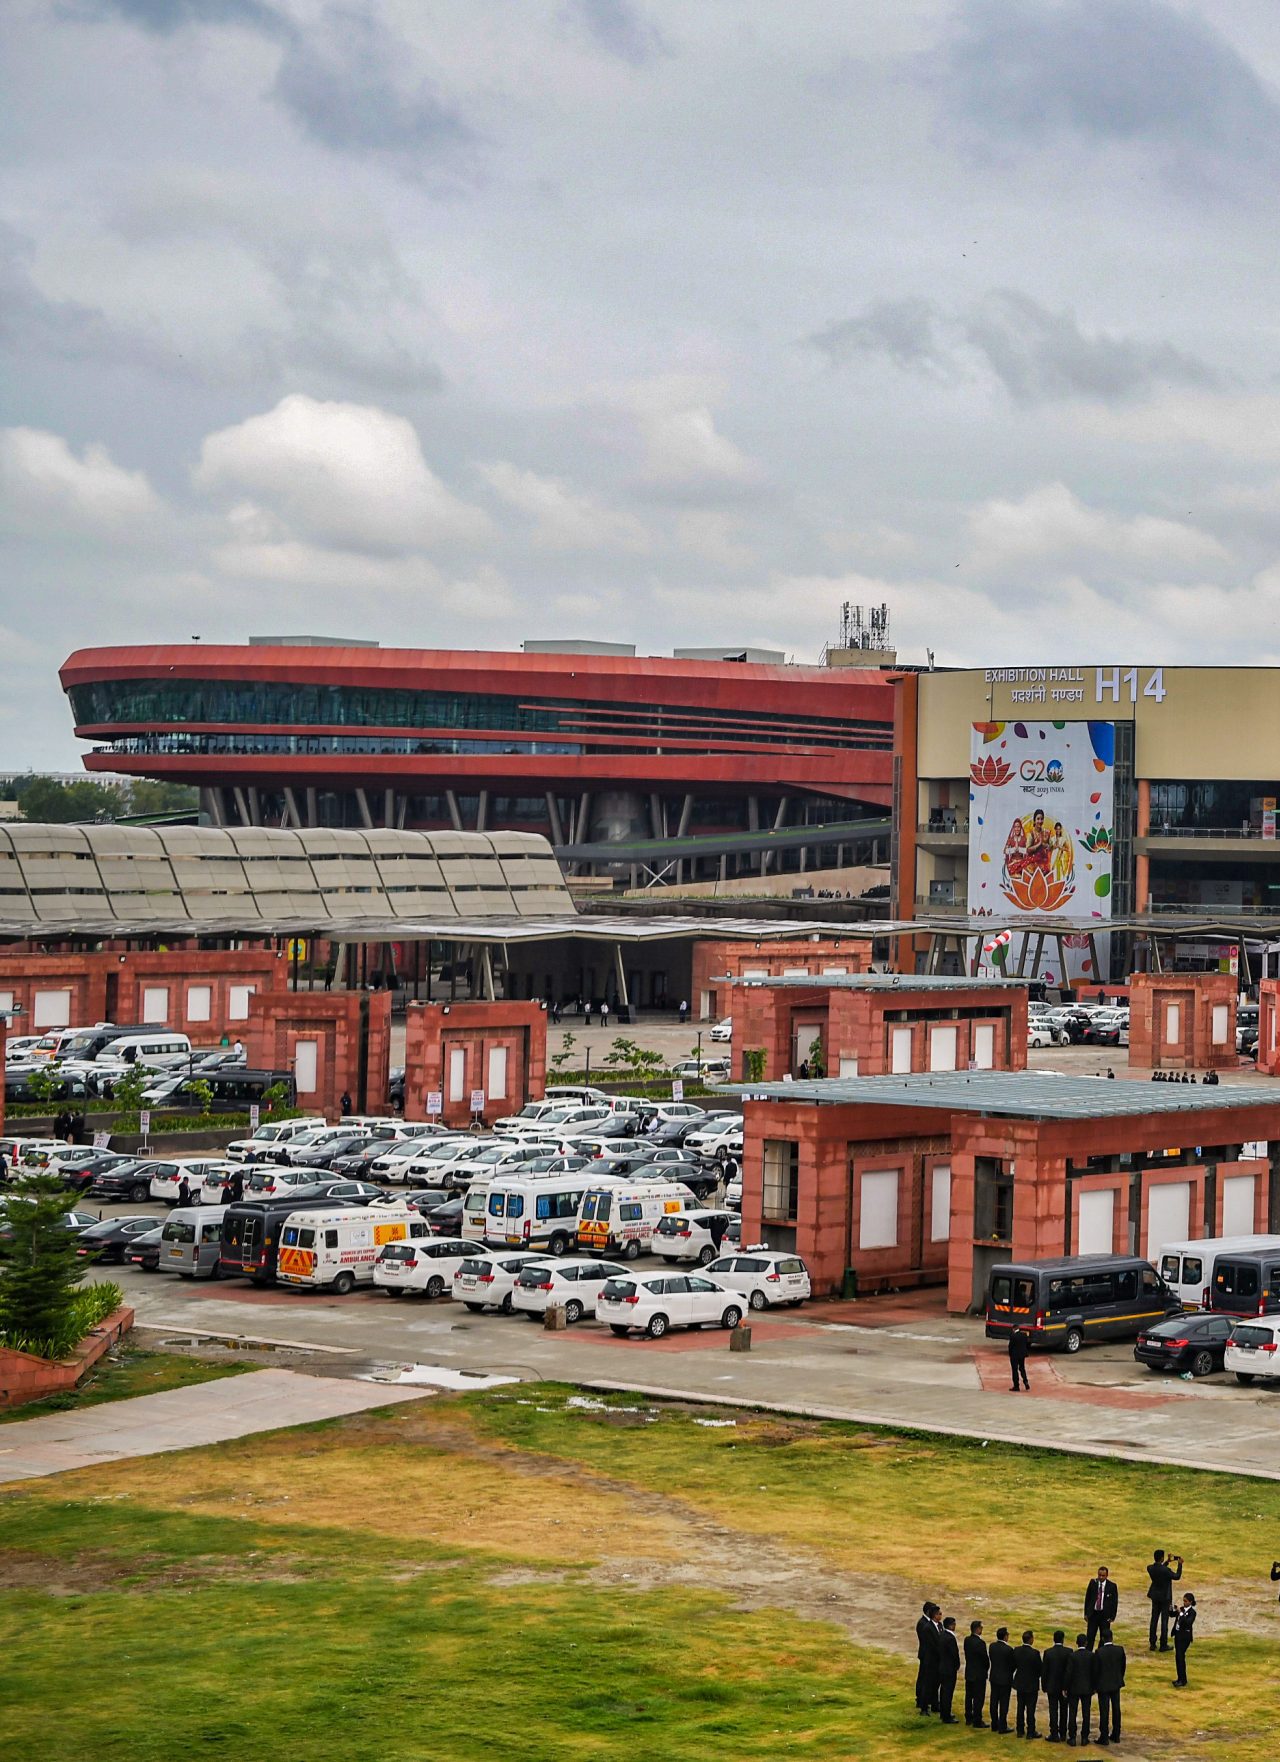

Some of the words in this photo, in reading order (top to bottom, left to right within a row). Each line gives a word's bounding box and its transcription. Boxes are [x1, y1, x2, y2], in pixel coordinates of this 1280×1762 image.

[984, 668, 1046, 683] EXHIBITION
[1049, 667, 1084, 682] HALL
[1011, 684, 1046, 703] प्रदर्शनी
[1051, 688, 1084, 702] मण्डप
[1095, 667, 1167, 703] H14
[1020, 759, 1064, 782] G20
[623, 1231, 650, 1240] AMBULANCE
[340, 1254, 376, 1264] AMBULANCE
